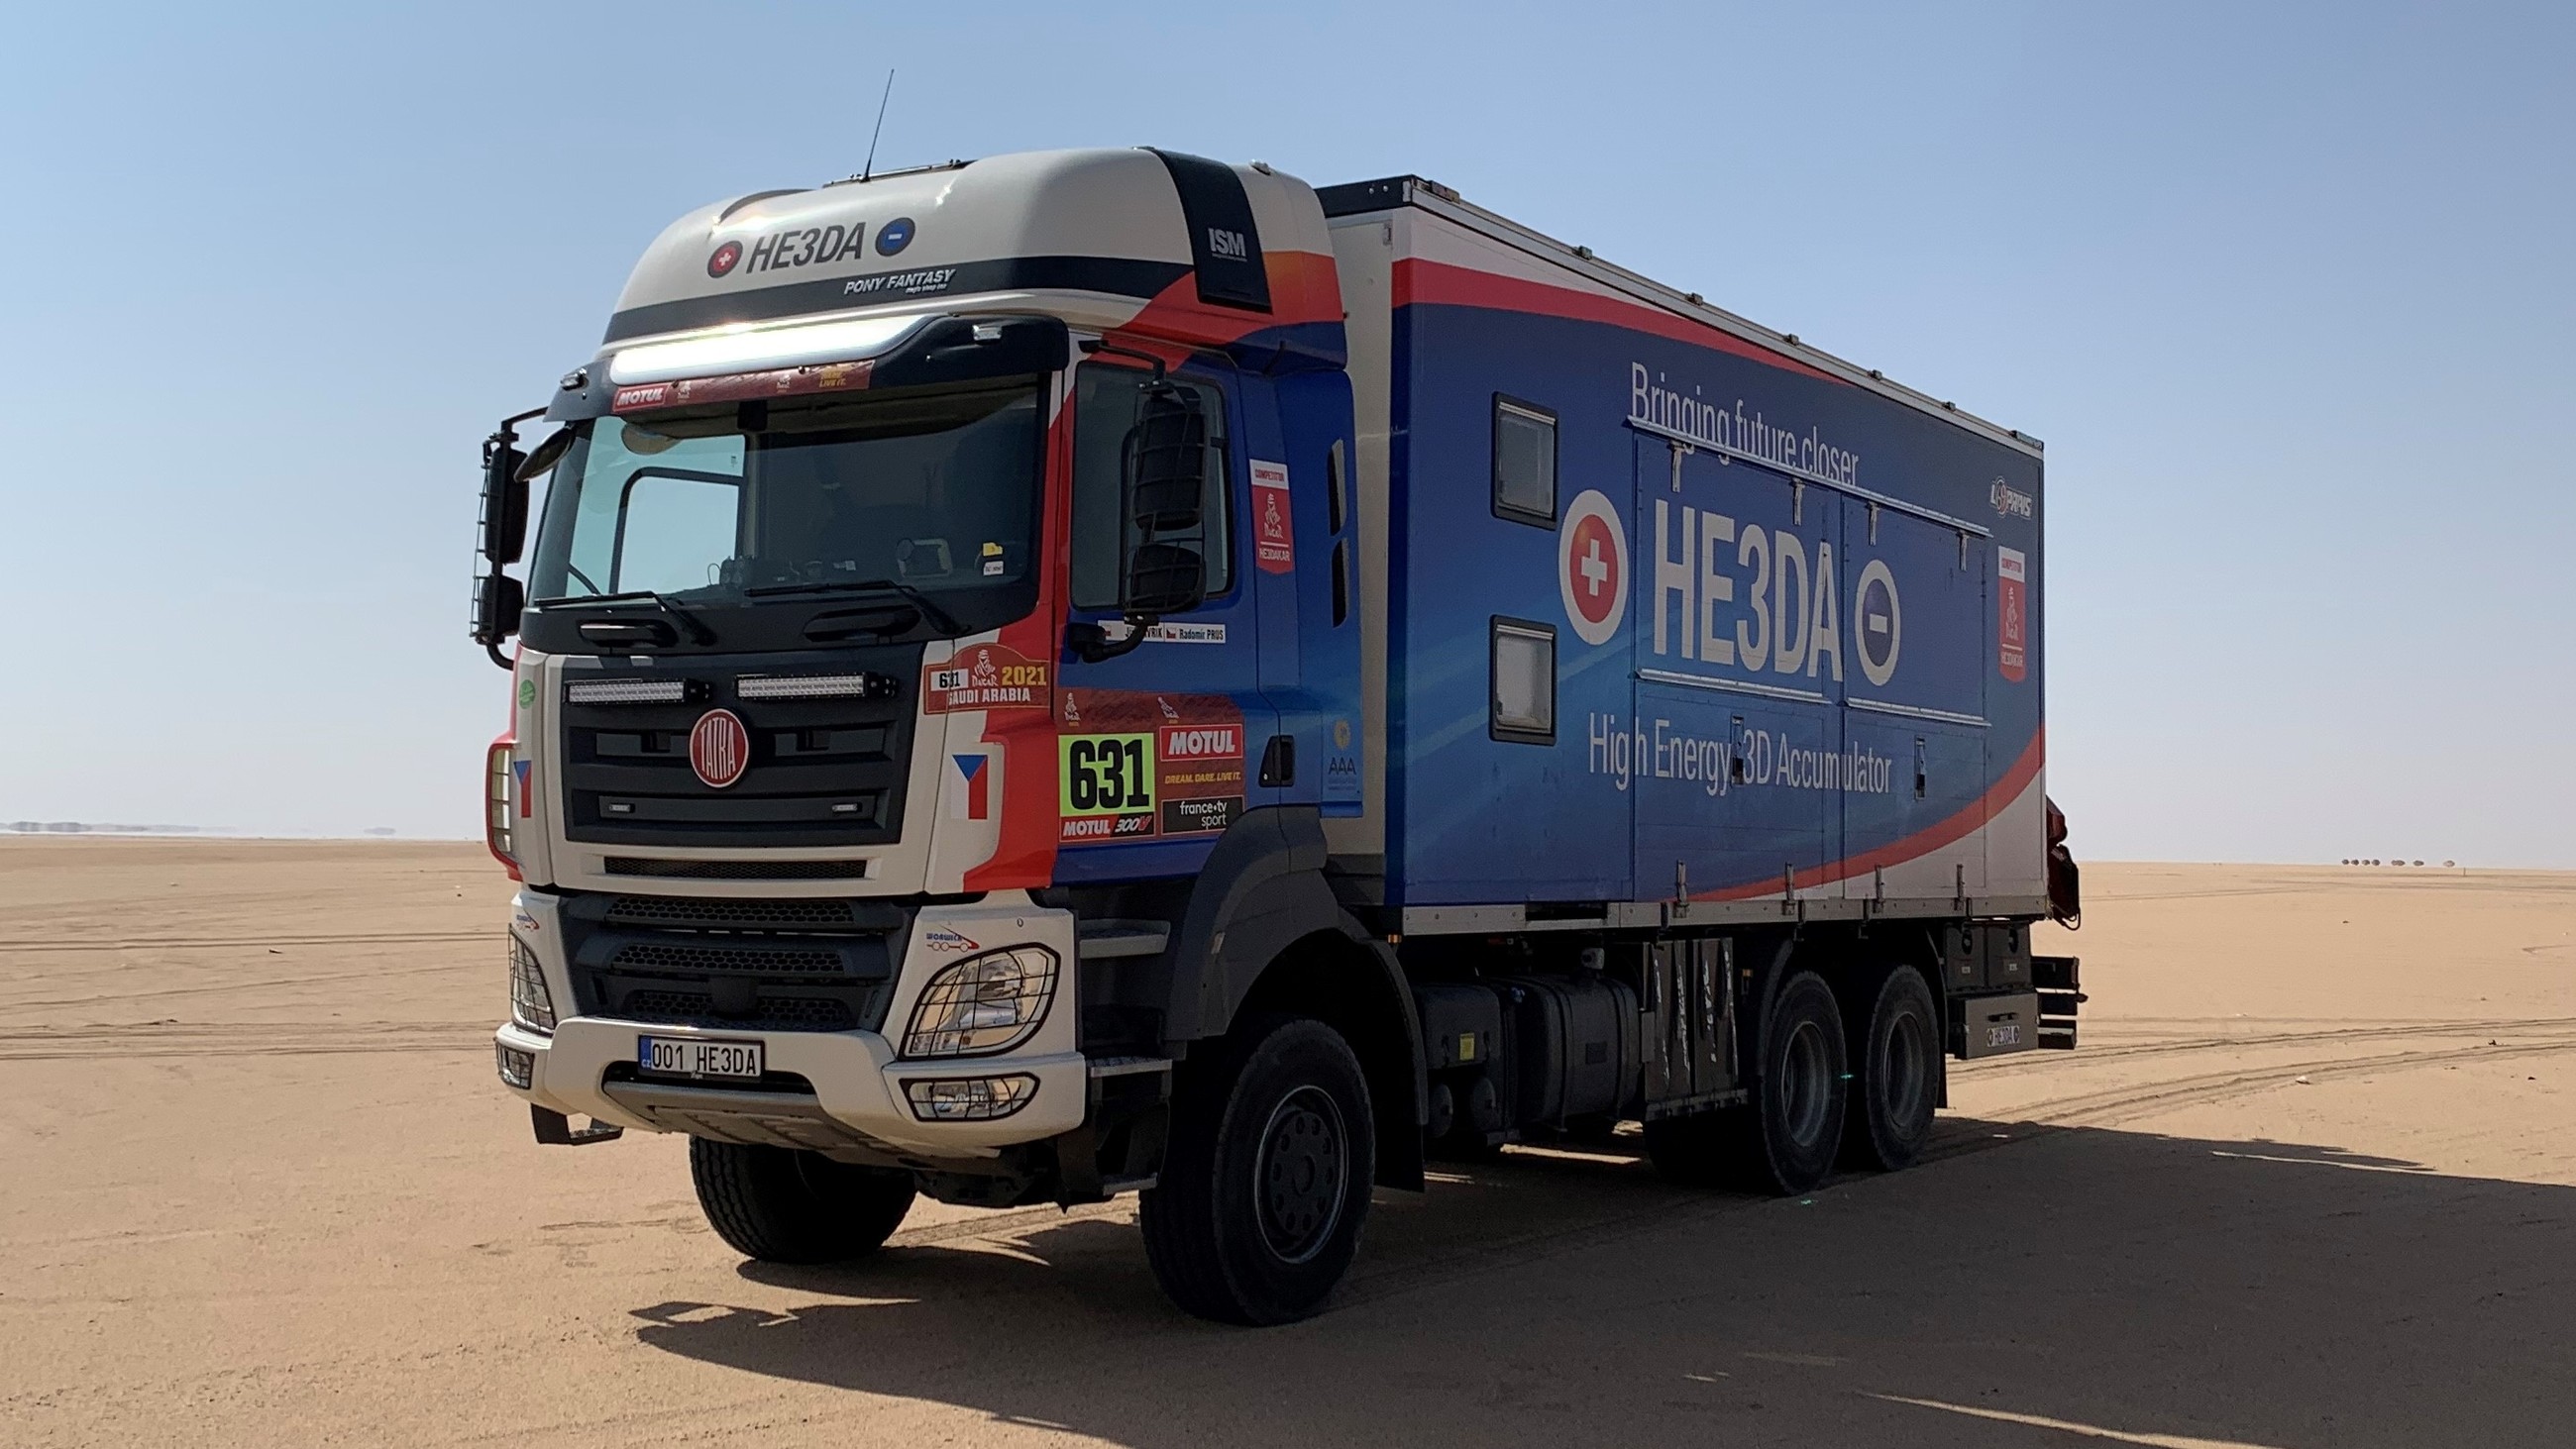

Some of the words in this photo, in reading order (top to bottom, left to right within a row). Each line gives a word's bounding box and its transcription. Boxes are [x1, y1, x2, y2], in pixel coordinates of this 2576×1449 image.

[746, 222, 866, 273] HE3DA
[1208, 228, 1246, 257] ISM
[844, 276, 886, 294] PONY
[887, 269, 956, 288] FANTASY
[617, 387, 664, 405] MOTUL
[1632, 362, 1731, 466] Bringing
[1735, 399, 1797, 470] future
[1802, 426, 1860, 486] closer
[1654, 498, 1844, 682] HE3DA
[1206, 629, 1225, 641] PRUS
[939, 672, 961, 688] 631
[1001, 666, 1047, 686] 2021
[948, 688, 979, 705] SAUDI
[982, 687, 1031, 702] ARABIA
[699, 717, 736, 780] TATRA
[1168, 730, 1236, 756] MOTUL
[1589, 712, 1648, 791] High
[1655, 719, 1733, 796] Energy
[1743, 729, 1771, 784] 3D
[1776, 733, 1892, 794] Accumulator
[1069, 739, 1150, 810] 631
[1329, 757, 1357, 775] AAA
[1063, 820, 1111, 836] MOTUL
[1115, 815, 1153, 833] 300V
[1201, 814, 1227, 831] sport
[641, 1059, 651, 1068] CZ
[652, 1043, 684, 1071] 001
[697, 1046, 757, 1075] HE3DA
